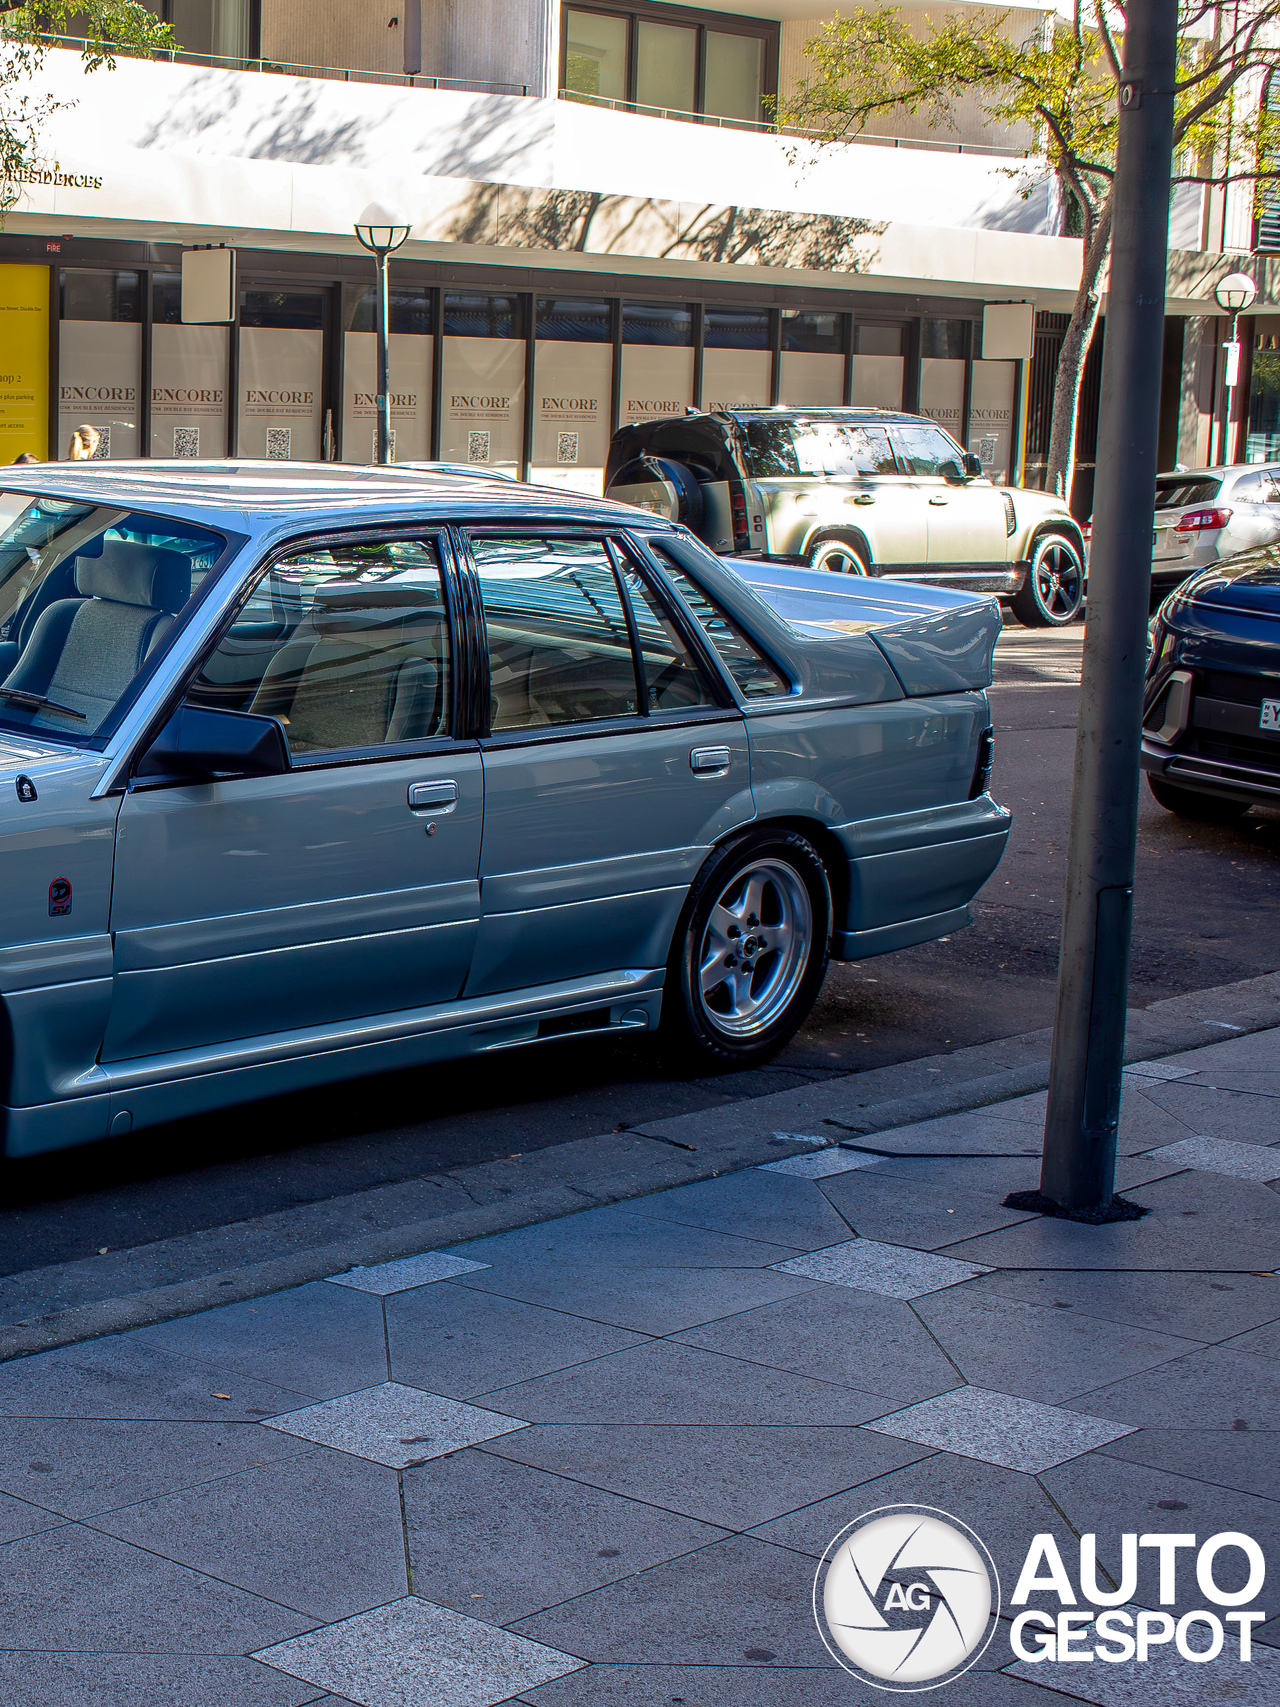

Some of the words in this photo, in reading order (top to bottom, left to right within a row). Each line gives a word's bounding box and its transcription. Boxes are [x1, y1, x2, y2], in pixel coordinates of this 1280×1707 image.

[47, 244, 61, 252] FIRE
[60, 386, 135, 400] ENCORE
[152, 388, 223, 402] ENCORE
[246, 390, 313, 404] ENCORE
[451, 396, 509, 408] ENCORE
[542, 398, 597, 410] ENCORE
[627, 400, 680, 412] ENCORE
[920, 408, 960, 418] ENCORE
[970, 409, 1009, 419] ENCORE
[1262, 705, 1270, 724] NSW
[51, 905, 70, 914] SV
